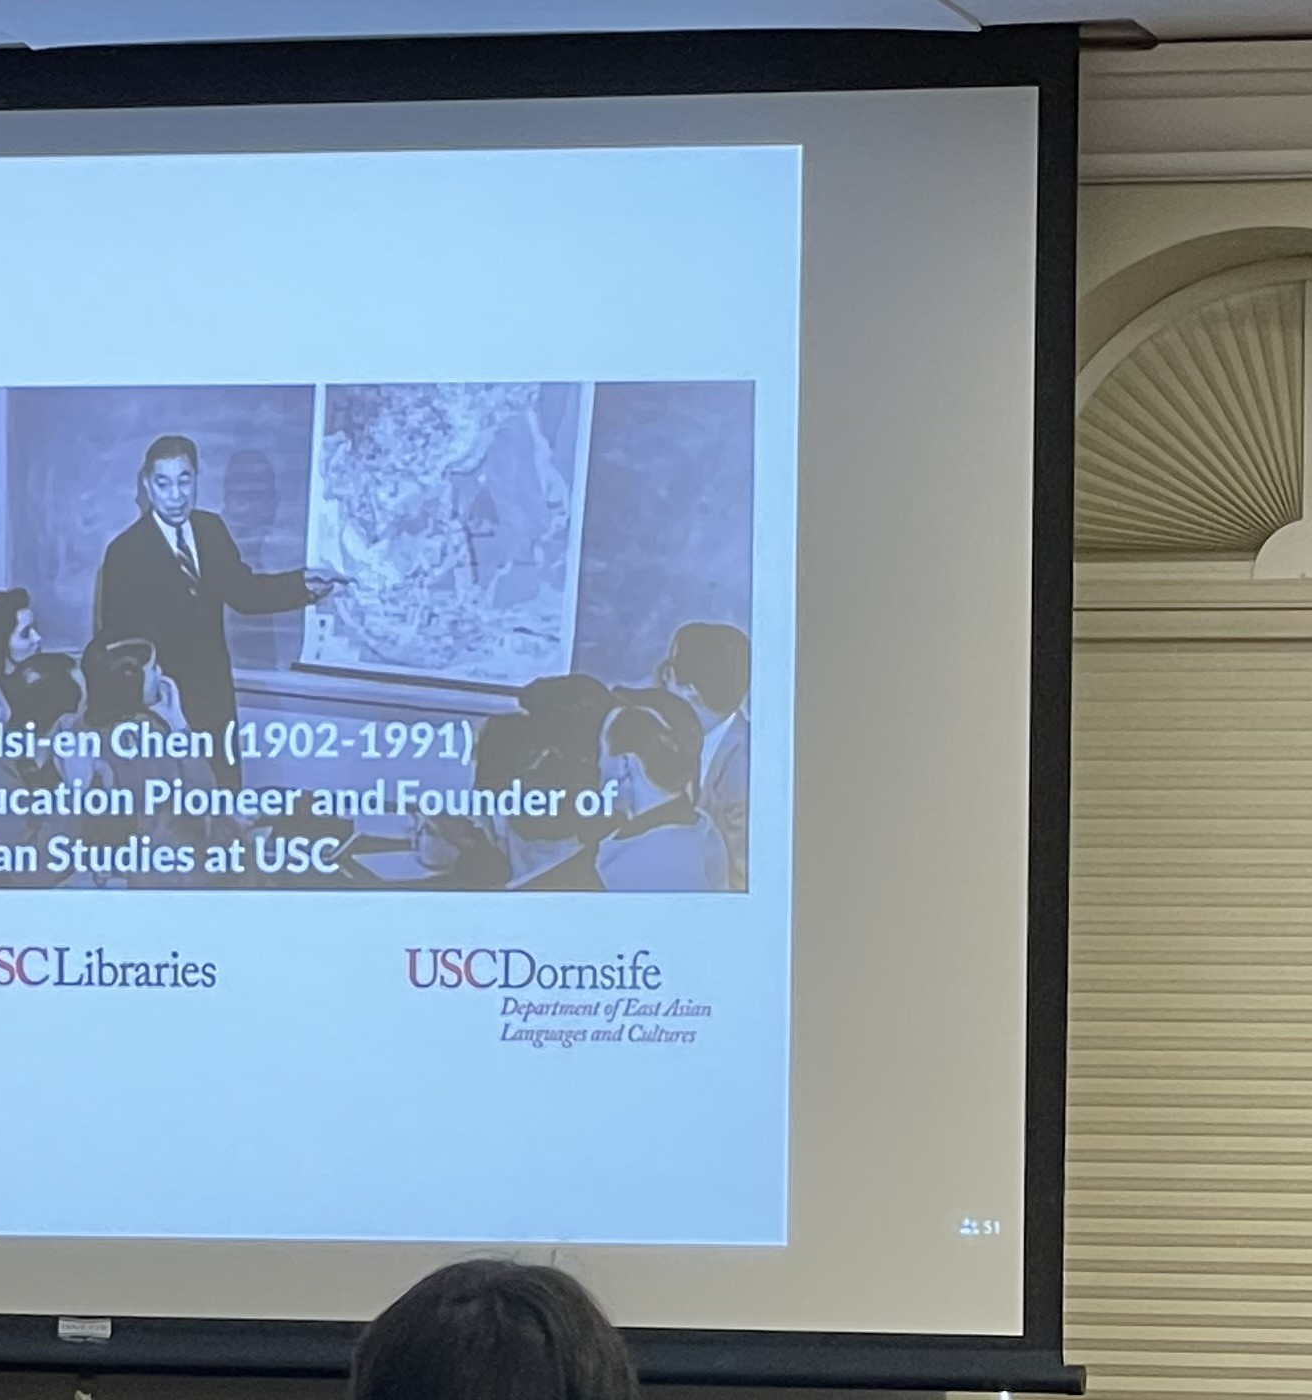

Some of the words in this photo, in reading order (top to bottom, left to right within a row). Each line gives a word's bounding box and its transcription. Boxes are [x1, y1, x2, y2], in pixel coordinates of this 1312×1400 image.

[111, 721, 214, 759] Chen
[225, 719, 475, 765] (1902-1991)
[145, 779, 301, 816] Pioneer
[311, 778, 386, 816] and
[397, 779, 567, 817] Founder
[575, 779, 619, 817] of
[47, 835, 195, 873] Studies
[204, 842, 245, 873] at
[255, 837, 341, 874] USC
[501, 998, 600, 1021] Department
[603, 998, 621, 1024] of
[623, 1000, 661, 1018] East
[664, 1000, 712, 1019] Asian
[501, 1023, 587, 1046] Languages
[591, 1025, 624, 1043] and
[628, 1025, 697, 1044] Cultures
